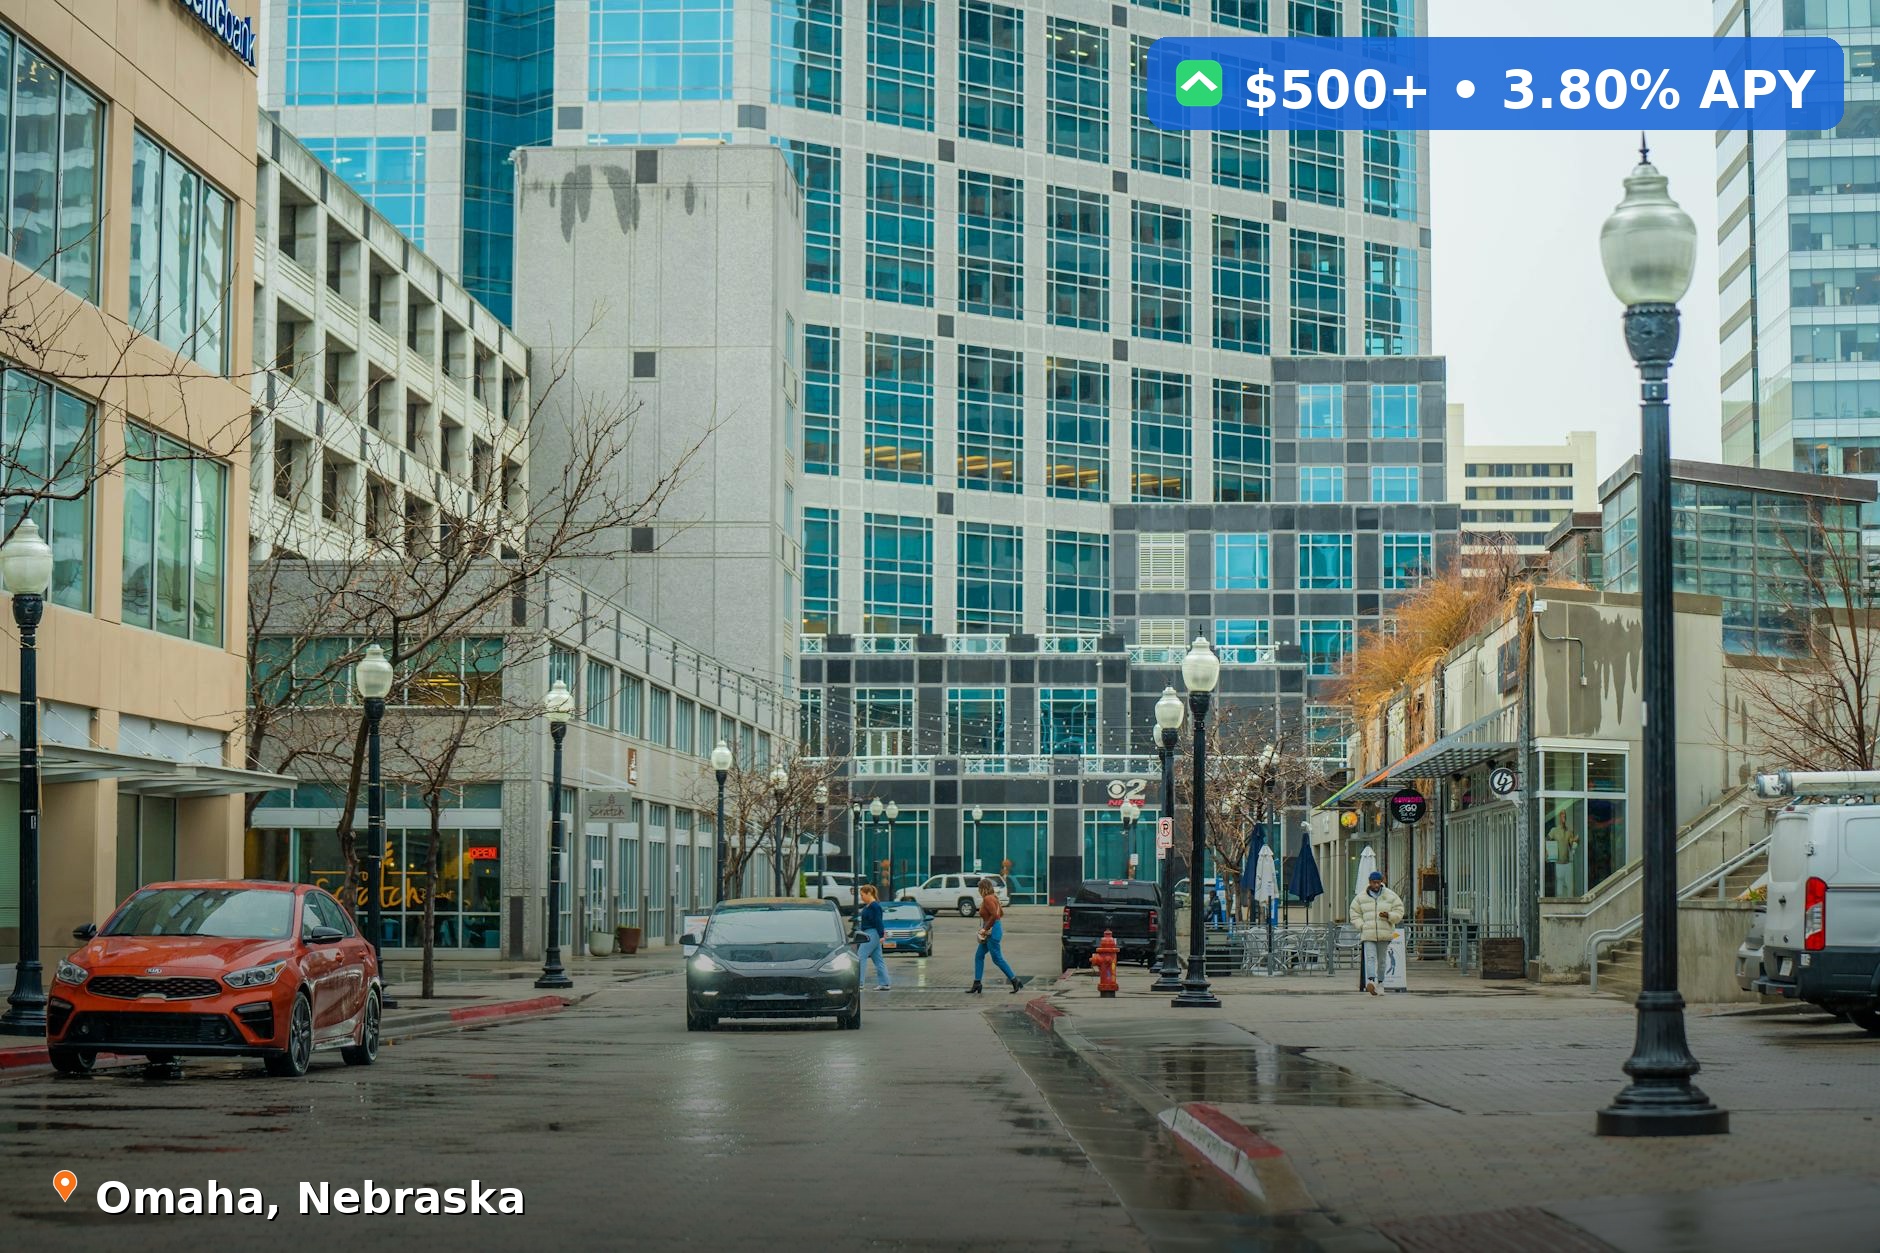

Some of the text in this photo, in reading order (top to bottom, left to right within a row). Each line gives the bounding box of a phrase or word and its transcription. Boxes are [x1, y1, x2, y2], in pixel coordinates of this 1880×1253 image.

[1126, 778, 1147, 799] 2
[588, 804, 625, 817] Scratch
[471, 848, 496, 858] OPEN
